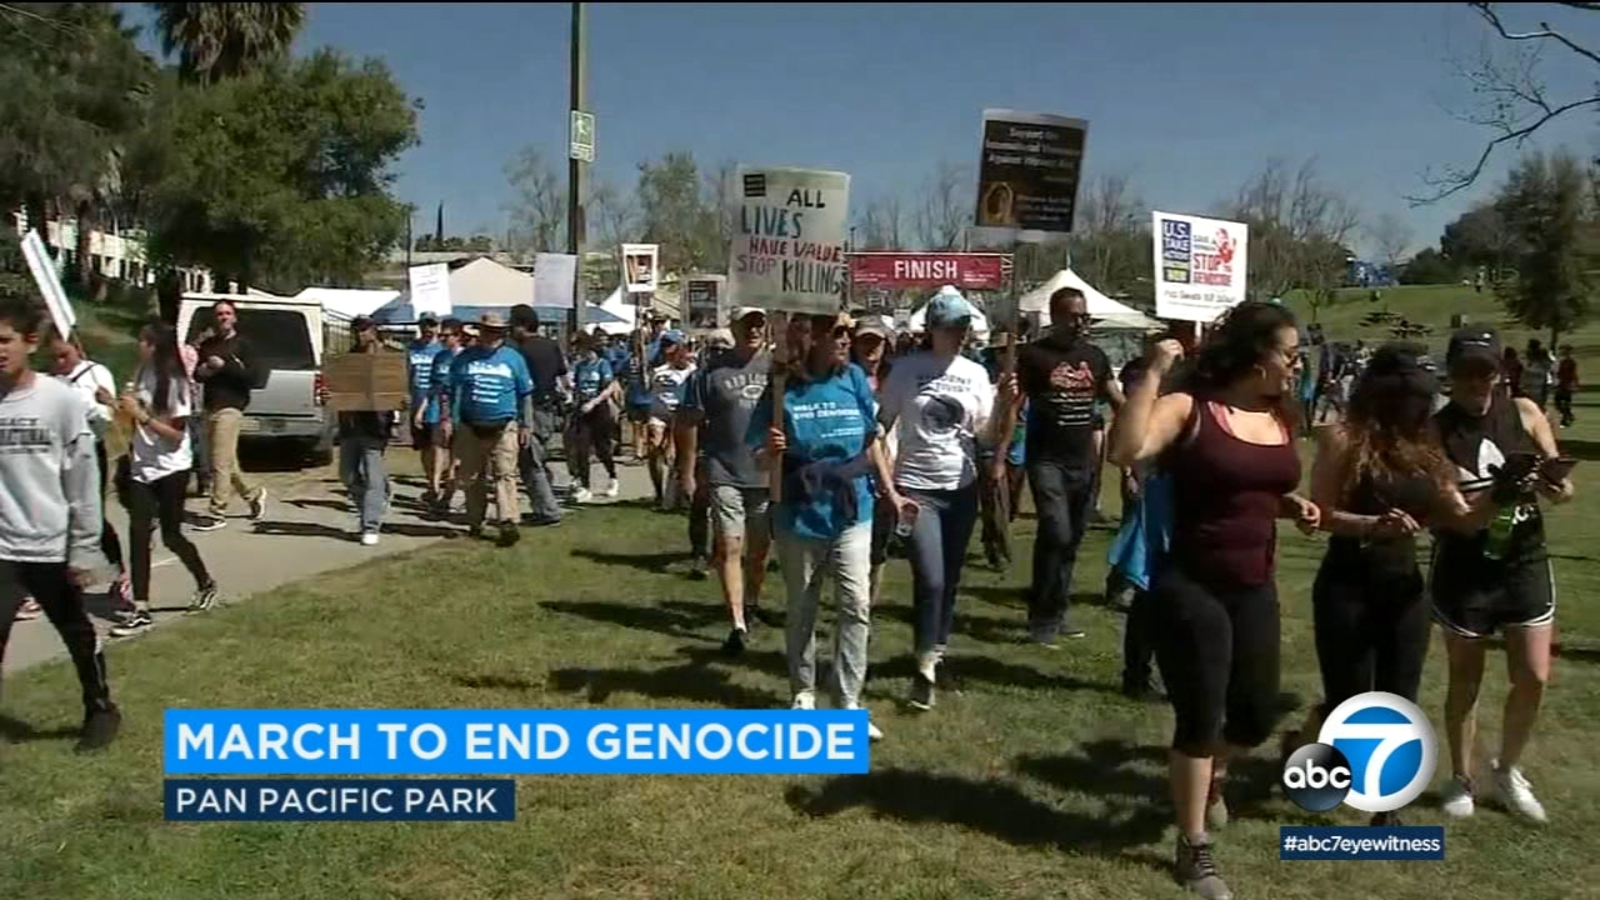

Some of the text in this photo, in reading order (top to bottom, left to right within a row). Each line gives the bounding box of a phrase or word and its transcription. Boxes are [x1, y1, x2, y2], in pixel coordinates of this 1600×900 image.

[786, 189, 826, 208] ALL
[741, 205, 803, 239] LIVES
[749, 236, 842, 262] HAVE VALUE
[894, 260, 958, 280] FINISH
[1193, 253, 1221, 271] STOP
[737, 254, 841, 295] STOP KILLING
